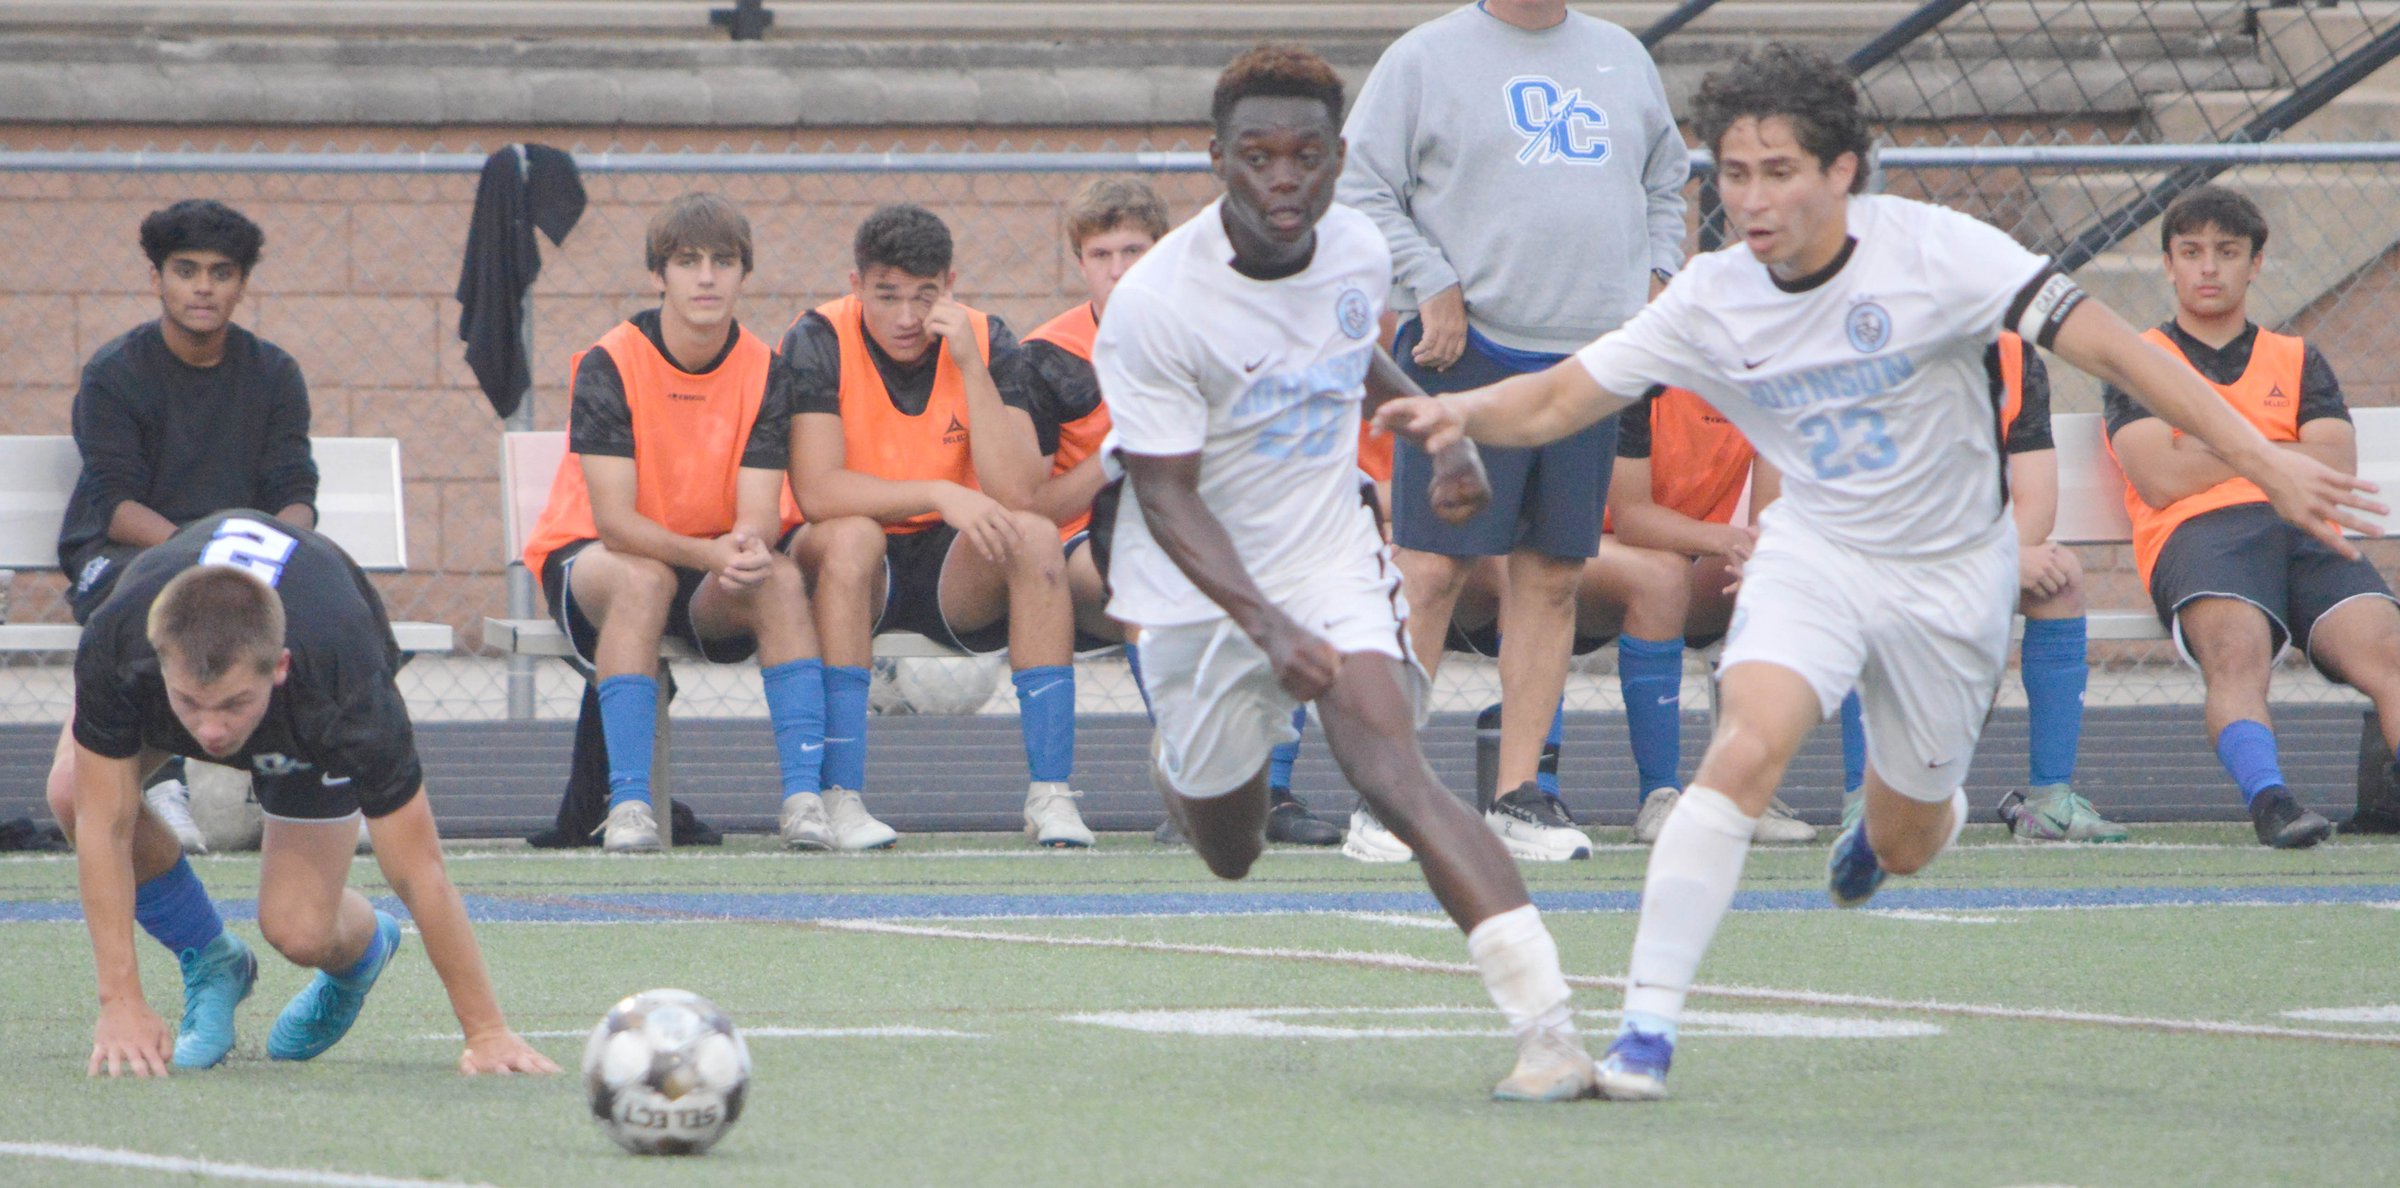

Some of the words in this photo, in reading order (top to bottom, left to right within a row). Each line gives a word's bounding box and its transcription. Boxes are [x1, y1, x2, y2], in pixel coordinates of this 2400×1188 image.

[1796, 407, 1900, 480] 23
[198, 518, 299, 588] 2
[622, 1103, 717, 1129] SELECT
